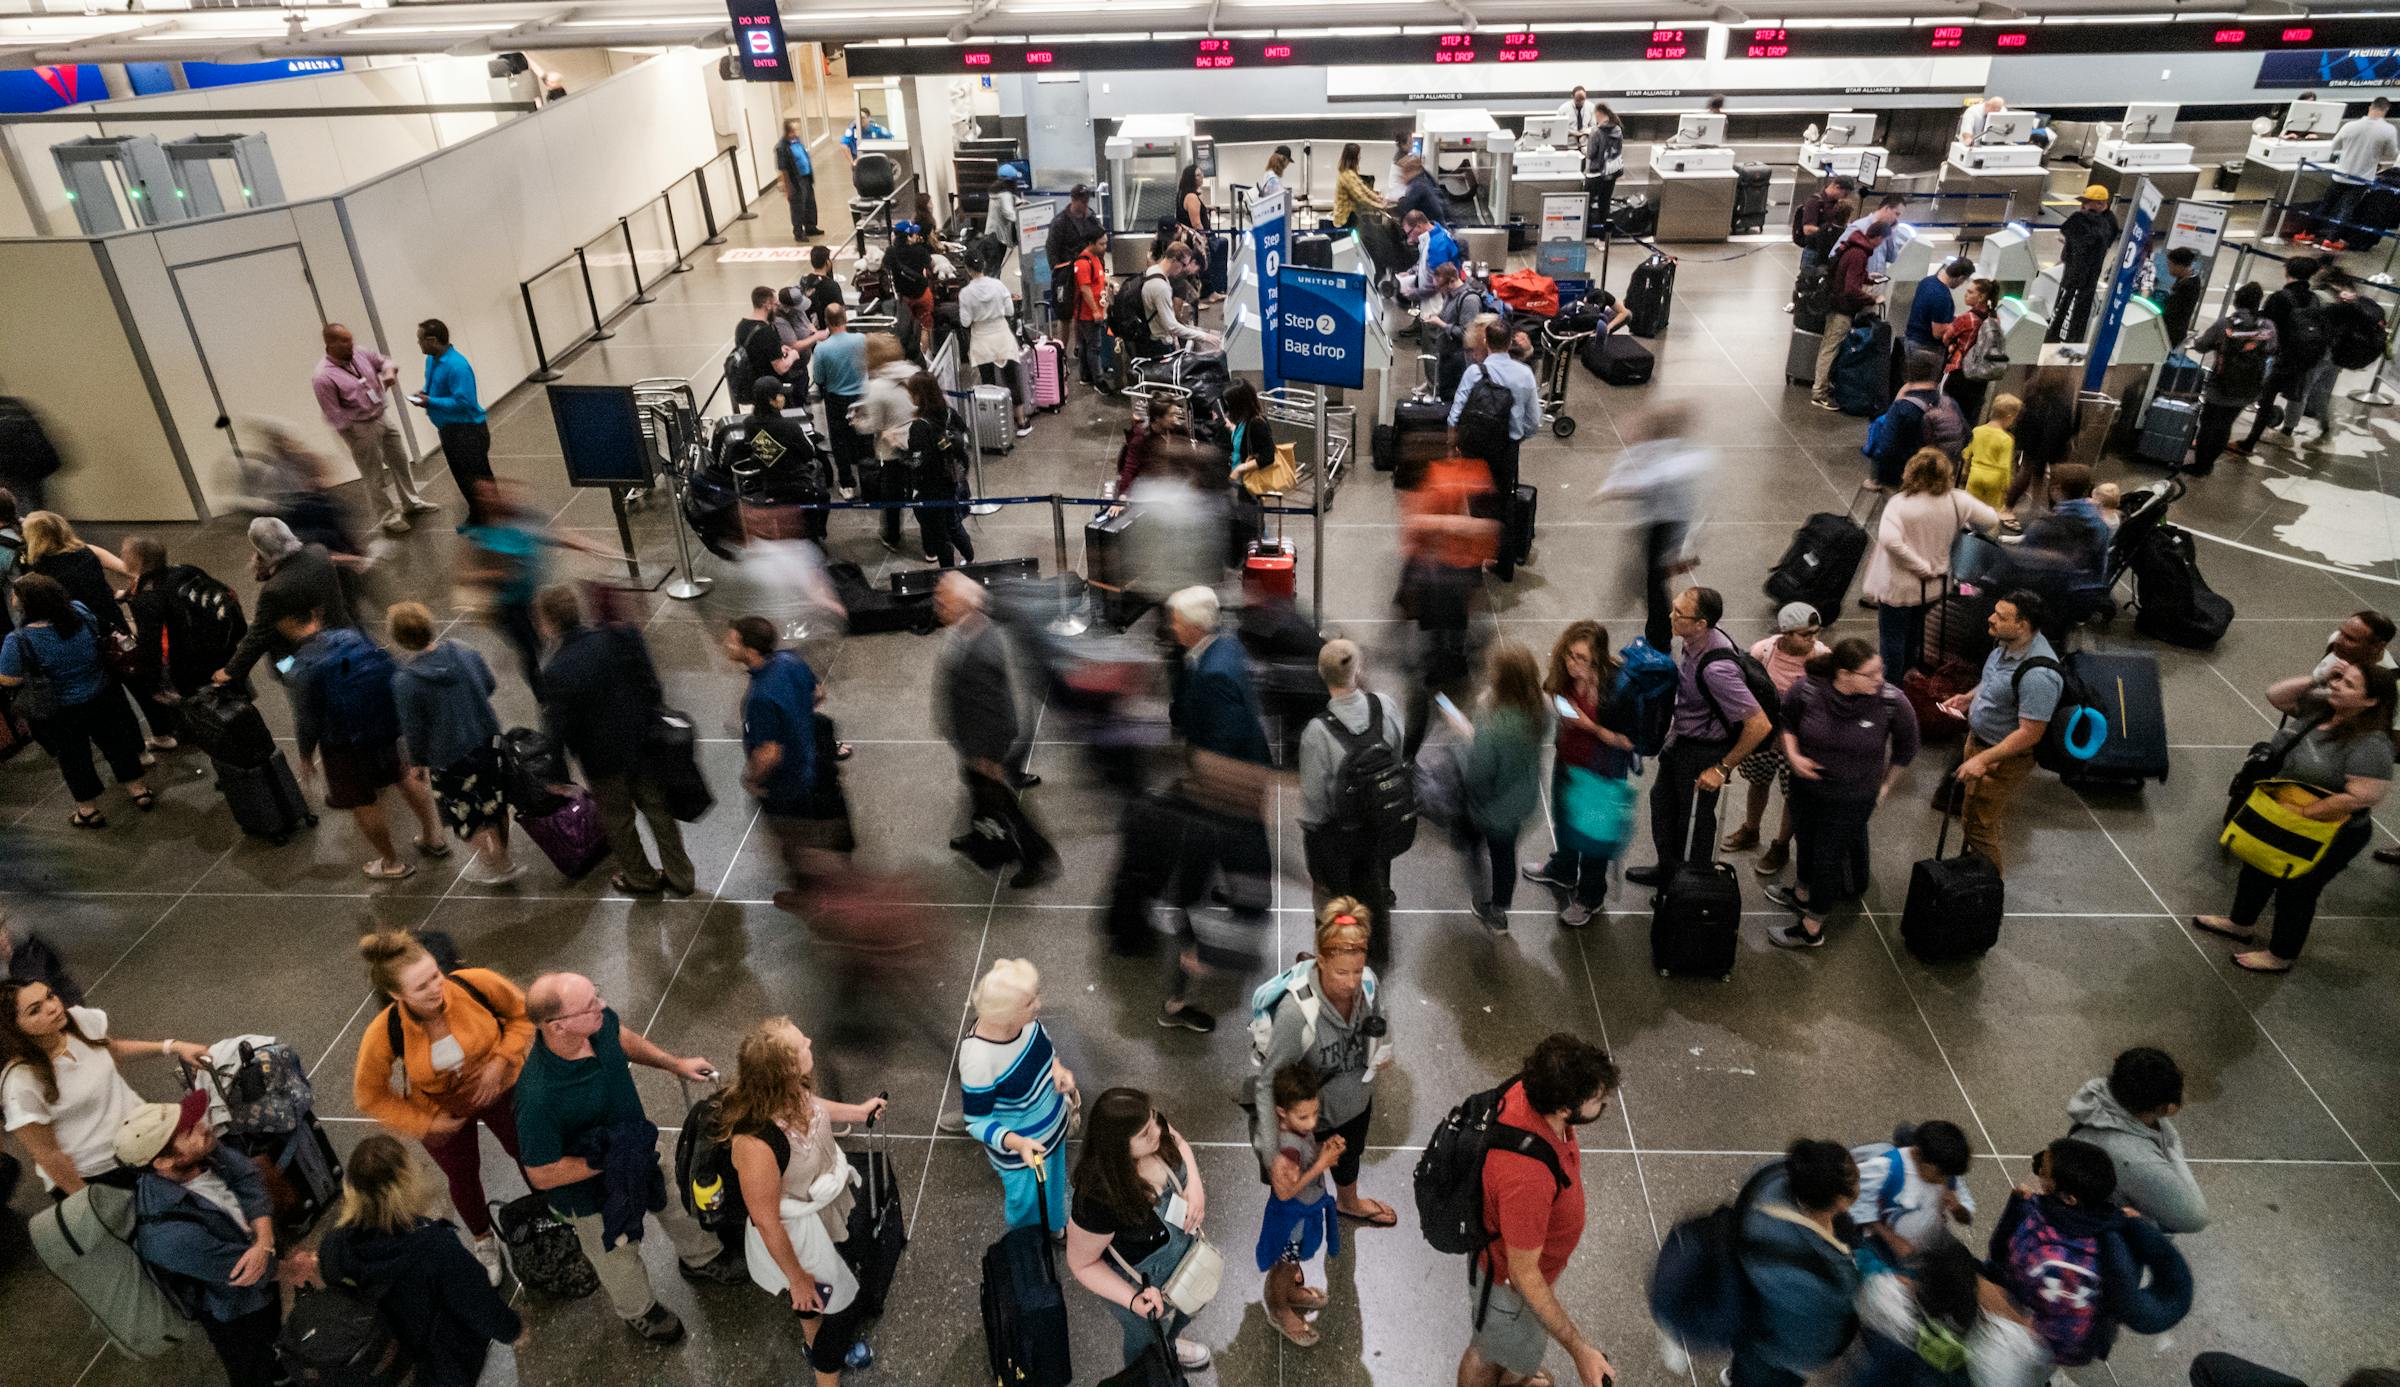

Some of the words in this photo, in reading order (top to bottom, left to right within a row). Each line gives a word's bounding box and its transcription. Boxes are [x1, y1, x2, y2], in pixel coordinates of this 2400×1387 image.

[739, 16, 752, 25] DO
[754, 16, 771, 25] NOT
[1653, 32, 1674, 42] STEP
[1676, 31, 1684, 41] 2
[1755, 30, 1776, 40] STEP
[1778, 30, 1786, 40] 2
[1934, 27, 1962, 38] UNITED
[2215, 30, 2245, 42] UNITED
[2282, 29, 2313, 41] UNITED
[1441, 35, 1462, 46] STEP
[1464, 35, 1471, 46] 2
[1505, 34, 1526, 45] STEP
[1528, 34, 1535, 44] 2
[1998, 35, 2026, 46] UNITED
[1200, 41, 1220, 51] STEP
[1222, 40, 1229, 50] 2
[1748, 47, 1765, 56] BAG
[1767, 46, 1788, 56] DROP
[1026, 53, 1052, 62] UNITED
[1264, 47, 1290, 57] UNITED
[1436, 52, 1452, 62] BAG
[1454, 51, 1475, 61] DROP
[1500, 51, 1516, 60] BAG
[1518, 50, 1539, 60] DROP
[1647, 48, 1664, 58] BAG
[1666, 47, 1686, 58] DROP
[753, 59, 778, 67] ENTER
[965, 54, 990, 64] UNITED
[1196, 57, 1212, 67] BAG
[1214, 56, 1234, 66] DROP
[297, 61, 331, 70] DELTA
[1264, 233, 1280, 249] Step
[1298, 276, 1335, 286] UNITED
[1265, 302, 1278, 320] you
[1284, 313, 1314, 331] Step
[1284, 338, 1310, 356] Bag
[1313, 341, 1346, 360] drop
